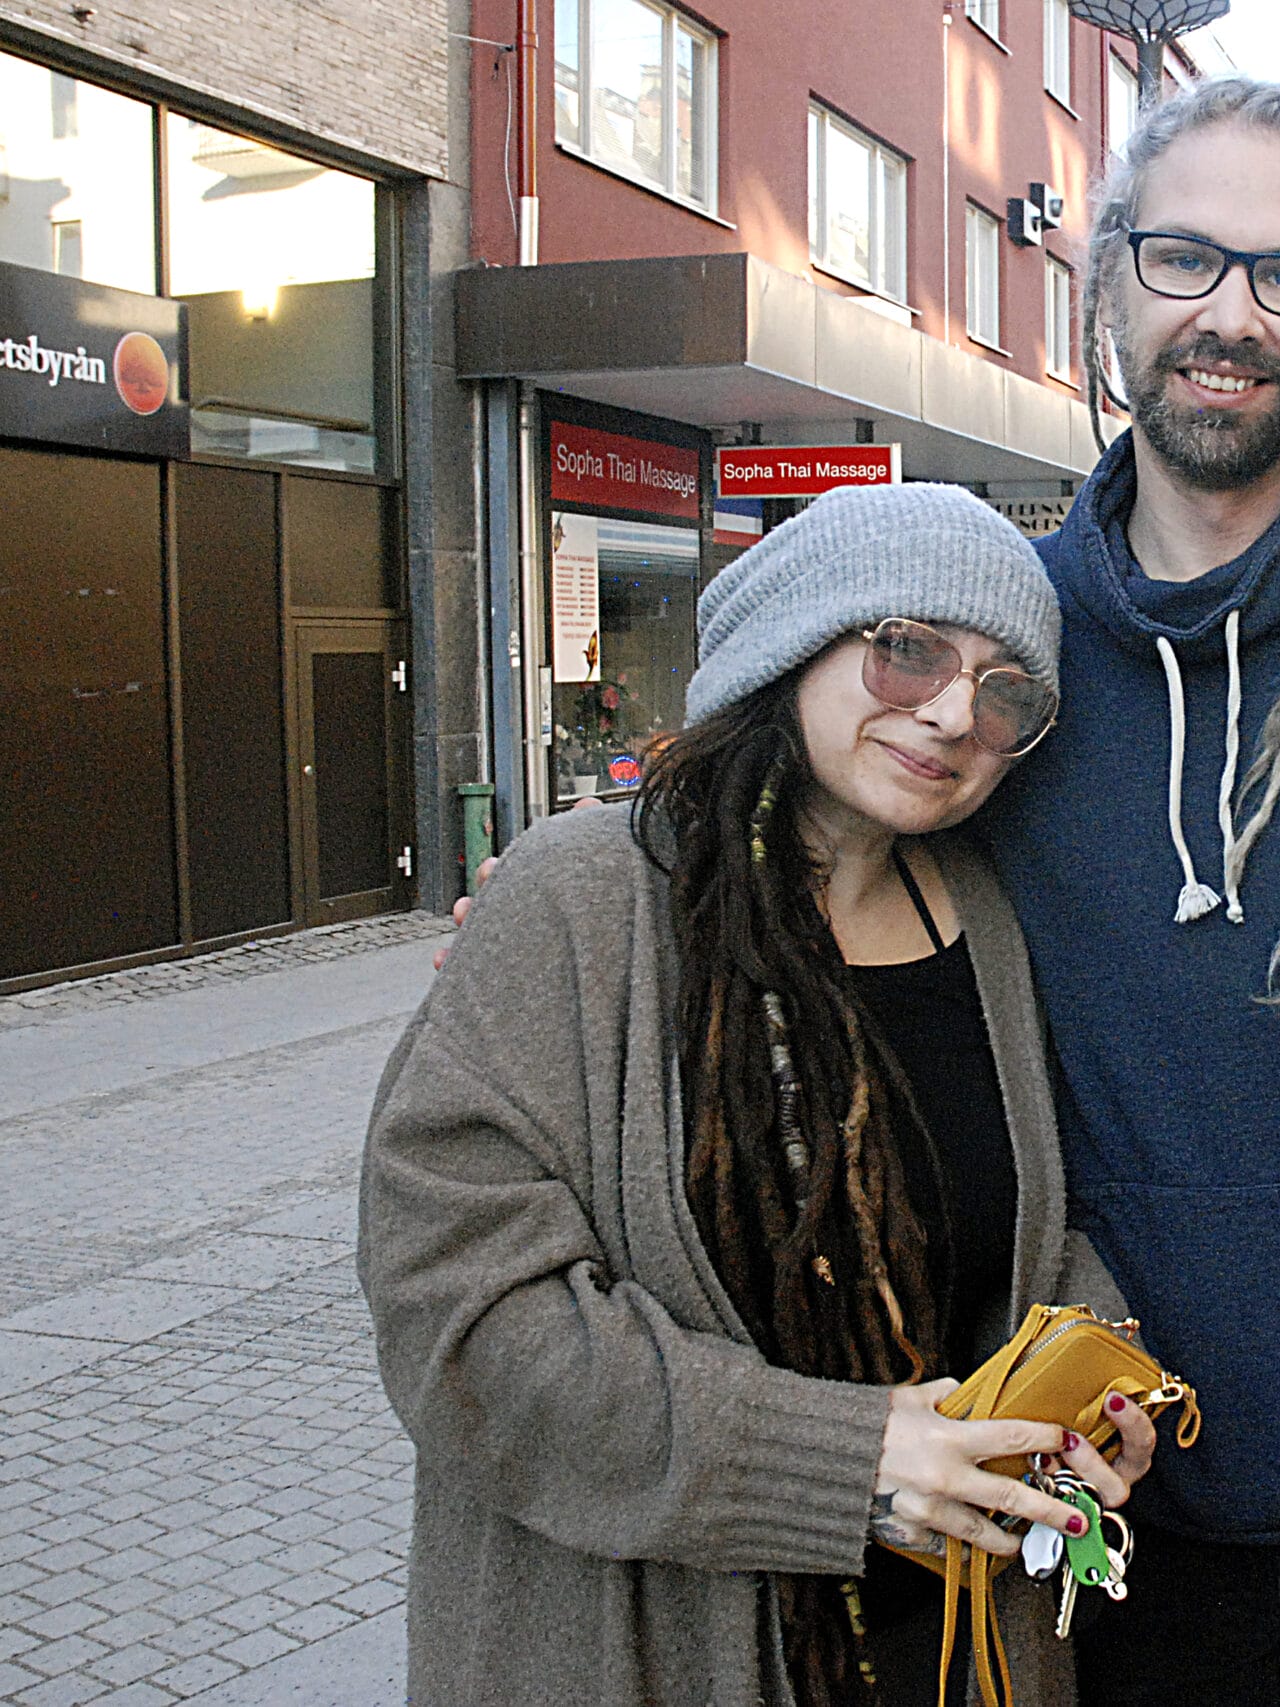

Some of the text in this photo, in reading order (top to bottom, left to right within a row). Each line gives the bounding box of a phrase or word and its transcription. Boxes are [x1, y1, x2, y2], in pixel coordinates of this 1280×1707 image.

[556, 443, 696, 498] Sopha Thai Massage
[724, 462, 887, 482] Sopha Thai Massage
